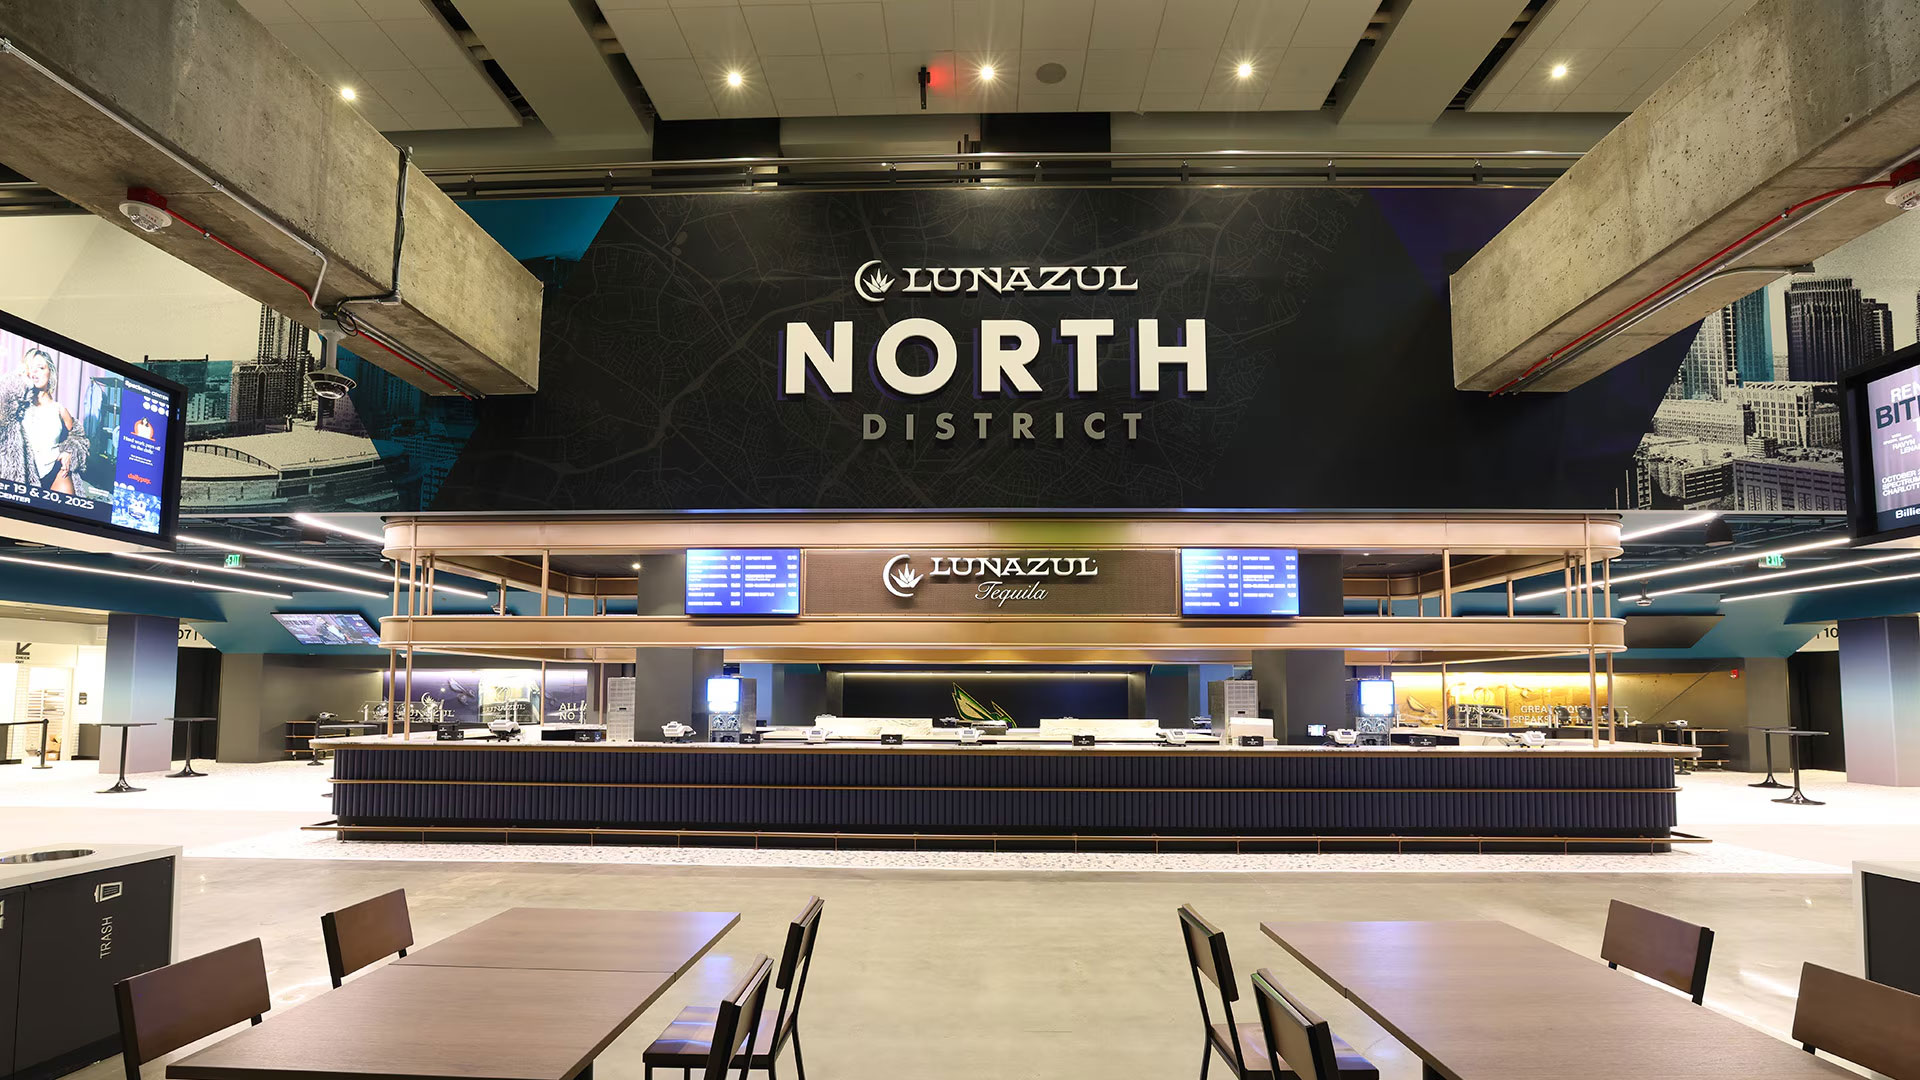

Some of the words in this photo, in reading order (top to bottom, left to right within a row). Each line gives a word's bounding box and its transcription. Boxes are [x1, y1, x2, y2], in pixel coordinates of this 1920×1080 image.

[902, 266, 1139, 293] LUNAZUL
[784, 317, 1208, 395] NORTH
[1875, 395, 1920, 429] BIT
[862, 412, 1143, 441] DISTRICT
[1882, 470, 1917, 484] OCTOBER
[13, 483, 27, 494] 19
[29, 488, 40, 498] &
[42, 490, 62, 504] 20,
[65, 496, 95, 510] 2025
[929, 557, 1098, 578] LUNAZUL
[974, 581, 1049, 608] Tequila
[559, 703, 578, 711] ALL
[560, 712, 576, 720] NO
[100, 915, 113, 959] TRASH
